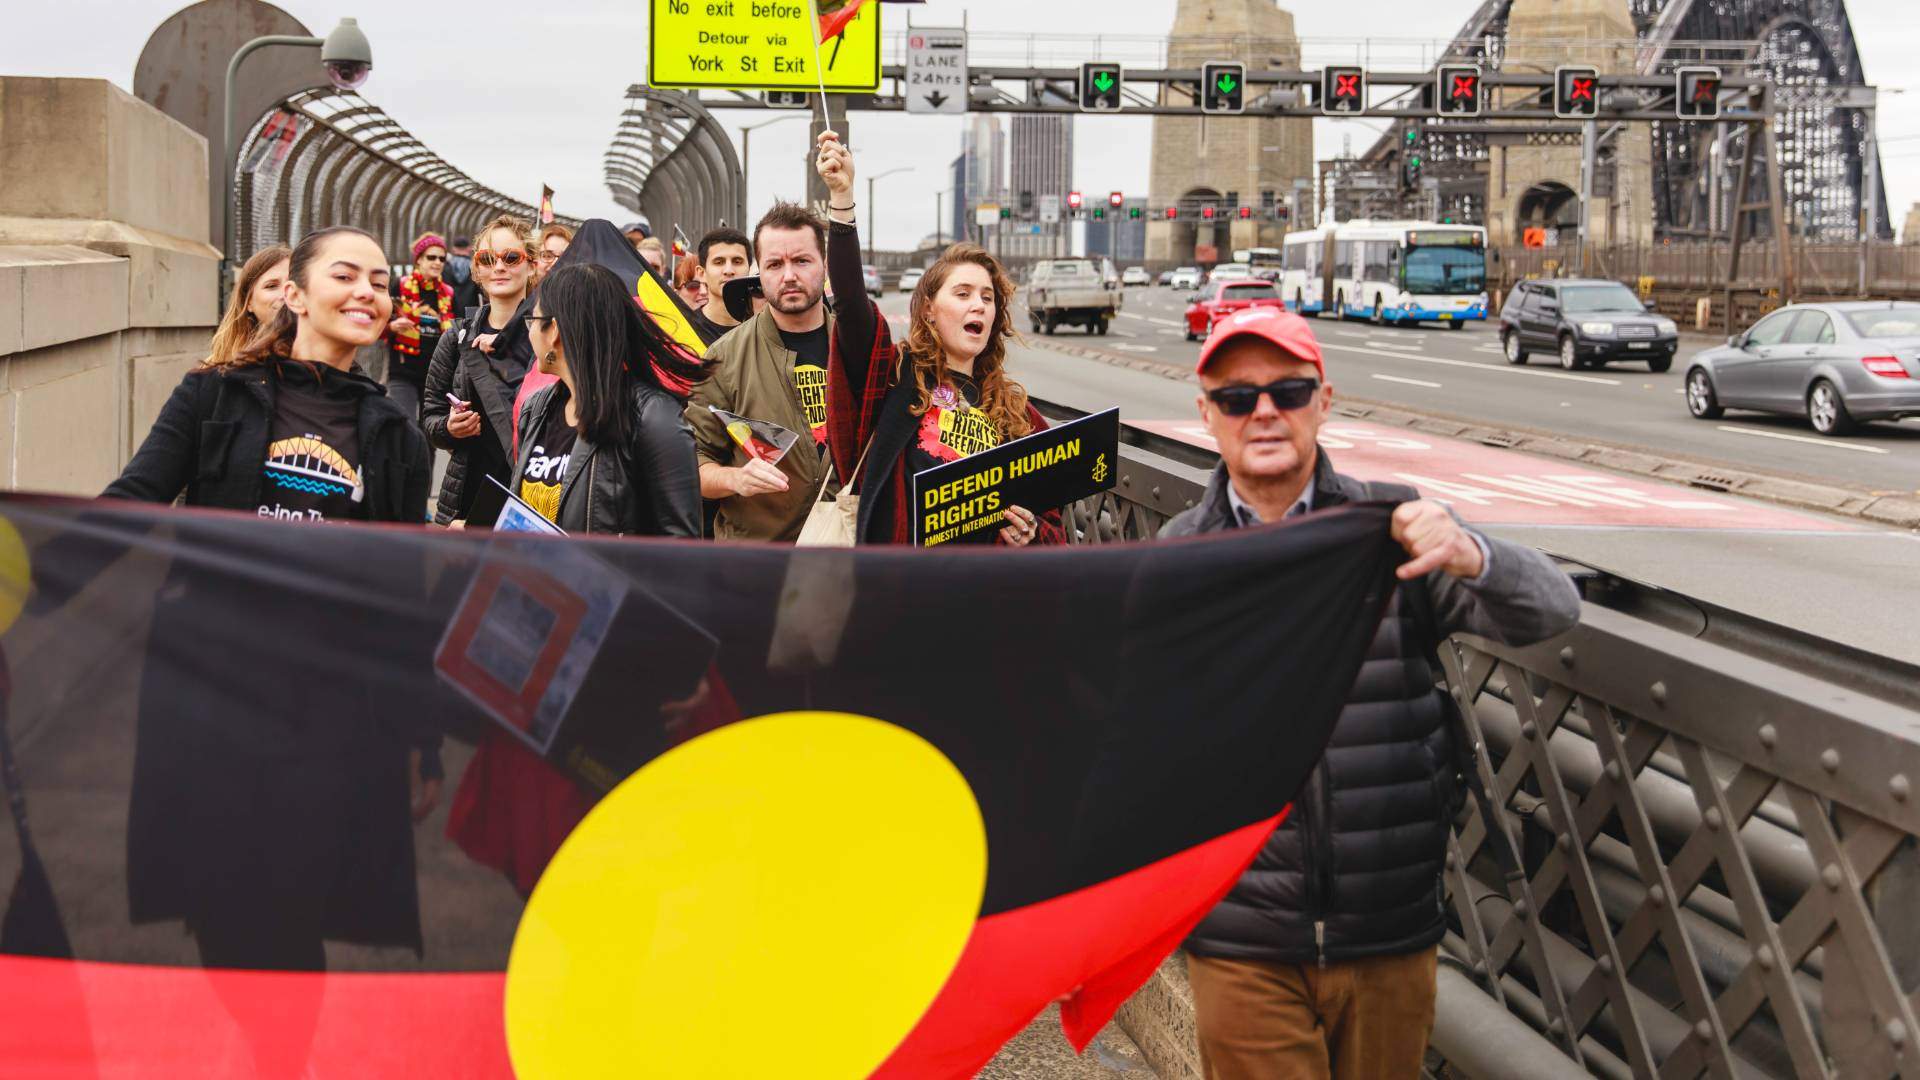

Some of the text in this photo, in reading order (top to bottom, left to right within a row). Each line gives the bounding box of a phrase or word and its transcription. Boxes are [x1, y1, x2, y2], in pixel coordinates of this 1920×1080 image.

[668, 0, 801, 19] No exit before
[699, 31, 787, 46] Detour via
[688, 55, 805, 73] York St Exit
[914, 55, 958, 67] LANE
[912, 72, 961, 84] 24hrs
[952, 414, 998, 448] RIGHTS
[939, 430, 991, 455] DEFEND
[924, 438, 1081, 510] DEFEND HUMAN
[924, 491, 1000, 533] RIGHTS
[924, 508, 1009, 548] AMNESTY INTERNATIO
